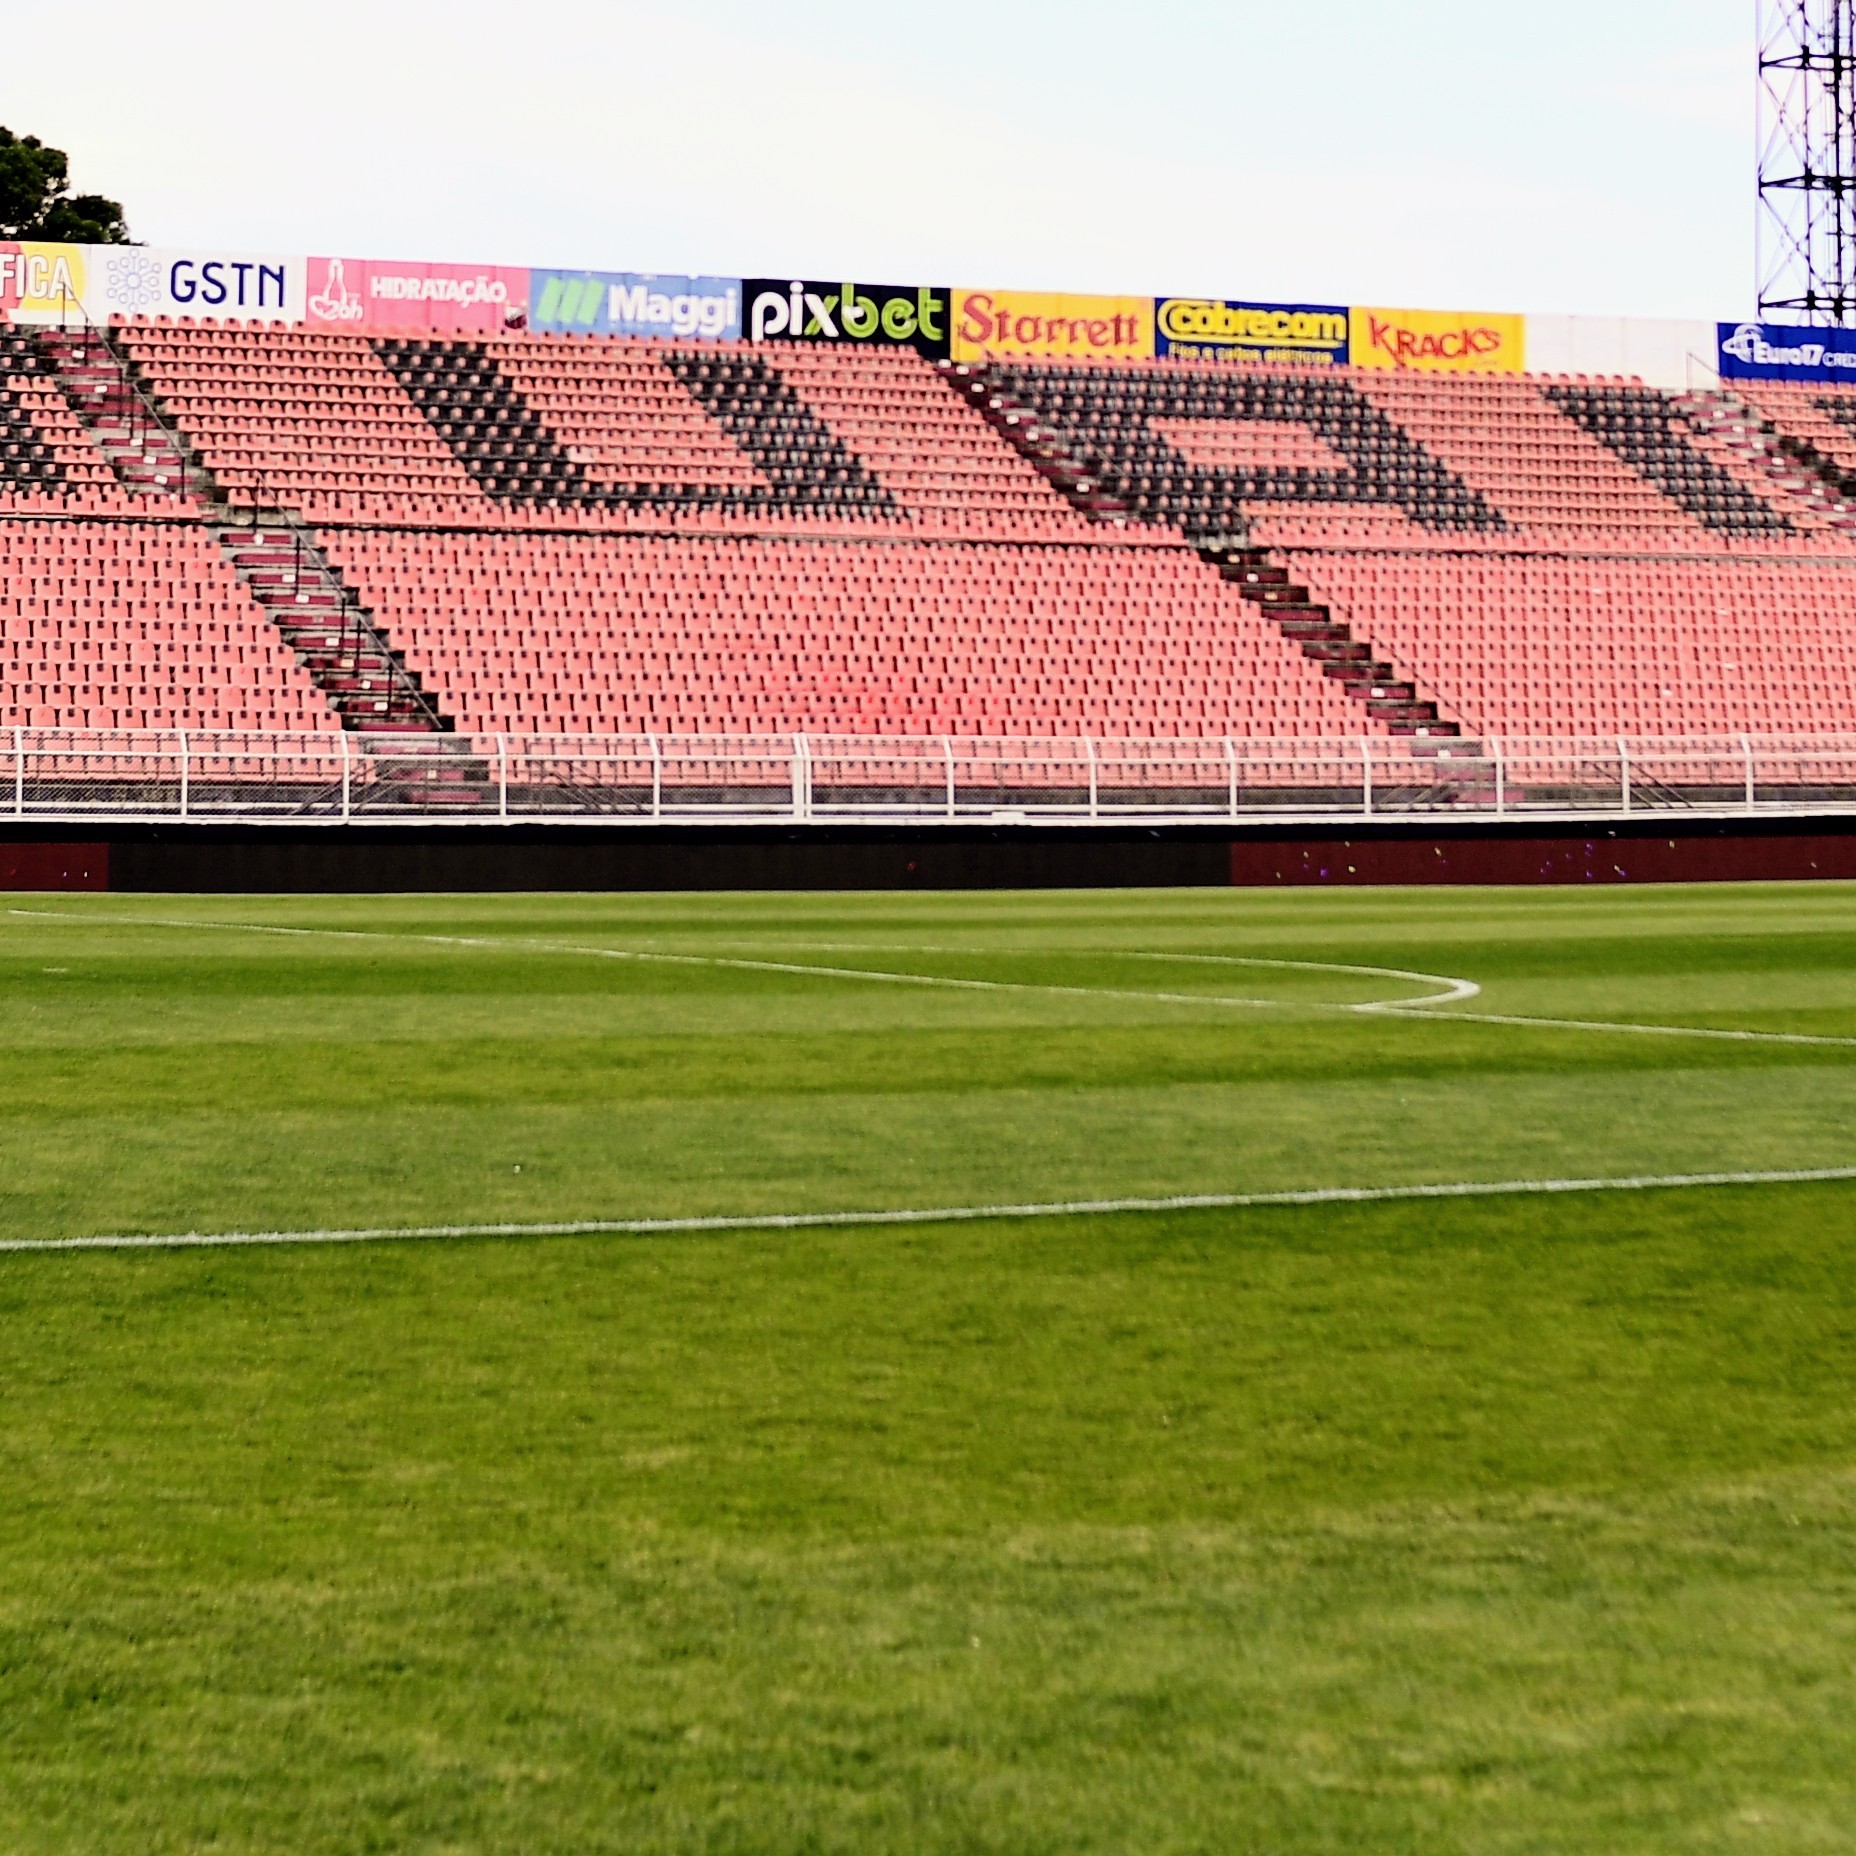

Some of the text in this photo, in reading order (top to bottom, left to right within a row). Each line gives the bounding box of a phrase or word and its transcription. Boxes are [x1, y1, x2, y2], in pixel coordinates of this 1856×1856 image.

[170, 259, 285, 308] GSTN
[370, 275, 508, 309] HIDRATAÇÃO
[607, 283, 738, 336] Maggi
[751, 280, 944, 343] pixbet
[958, 293, 1140, 348] Starrett
[1367, 314, 1502, 367] KRACKS
